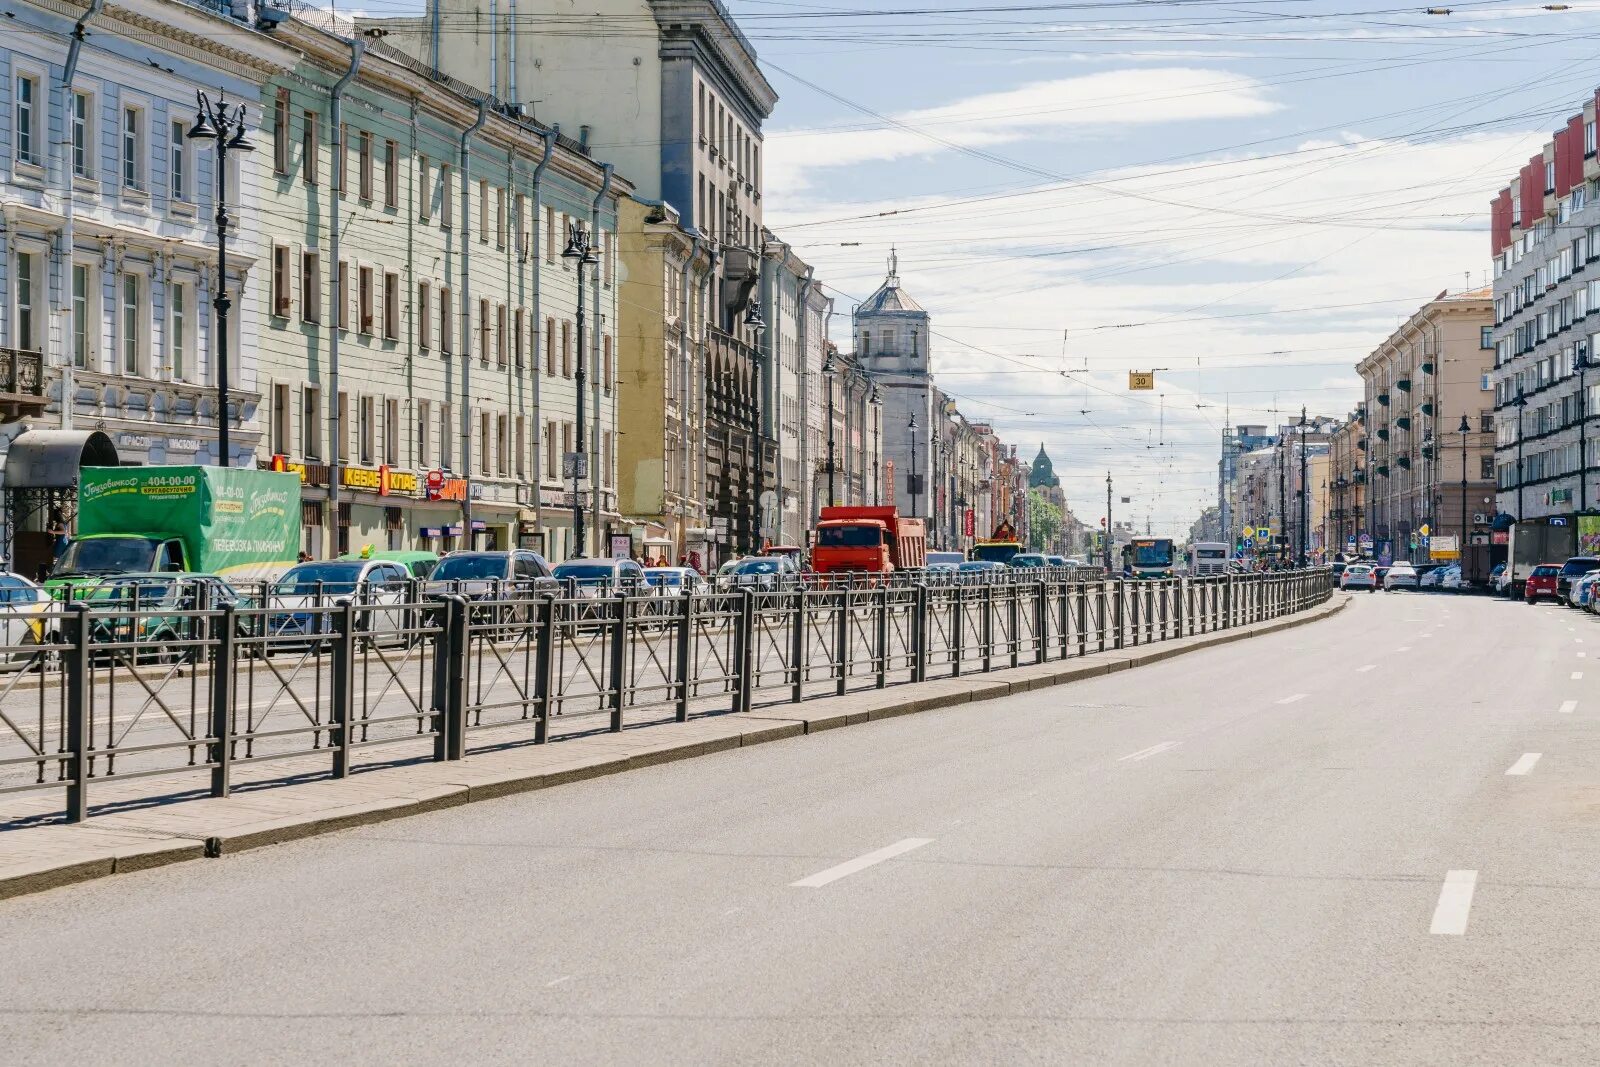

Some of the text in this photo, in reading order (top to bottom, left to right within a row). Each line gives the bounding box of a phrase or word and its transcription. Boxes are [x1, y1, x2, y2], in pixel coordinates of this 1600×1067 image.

[148, 475, 196, 487] 404-00-00
[346, 468, 417, 490] КЕБАБ КЛАБ
[143, 486, 194, 494] КРУГЛОСУТОЧНО
